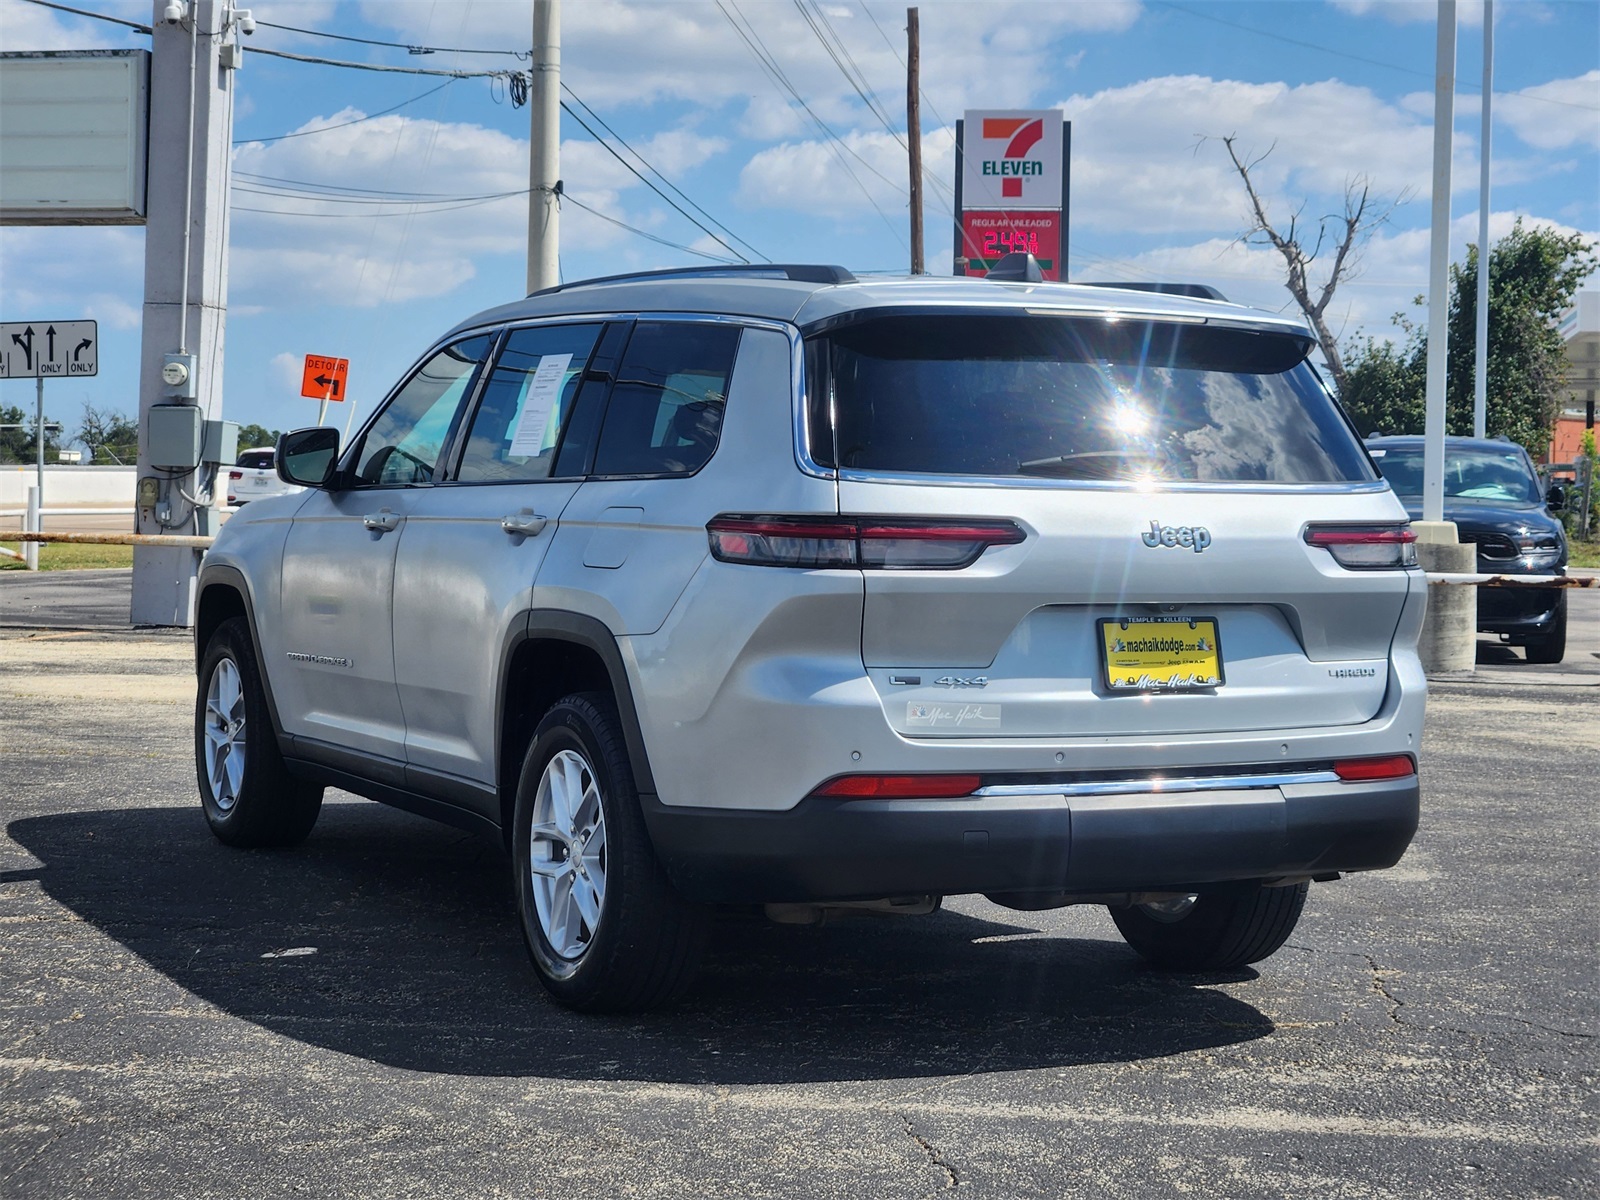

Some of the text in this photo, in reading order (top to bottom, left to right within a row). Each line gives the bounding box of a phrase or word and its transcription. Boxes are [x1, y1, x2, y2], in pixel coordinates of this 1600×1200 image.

[971, 219, 1052, 228] REGULAR UNLEADED
[41, 364, 62, 373] ONLY
[70, 363, 94, 372] ONLY
[308, 359, 346, 372] DETOUR
[1141, 519, 1211, 553] Jeep
[1126, 637, 1196, 655] machaikdodge.com
[934, 676, 989, 686] 4x4
[1136, 673, 1197, 689] Mac Haik
